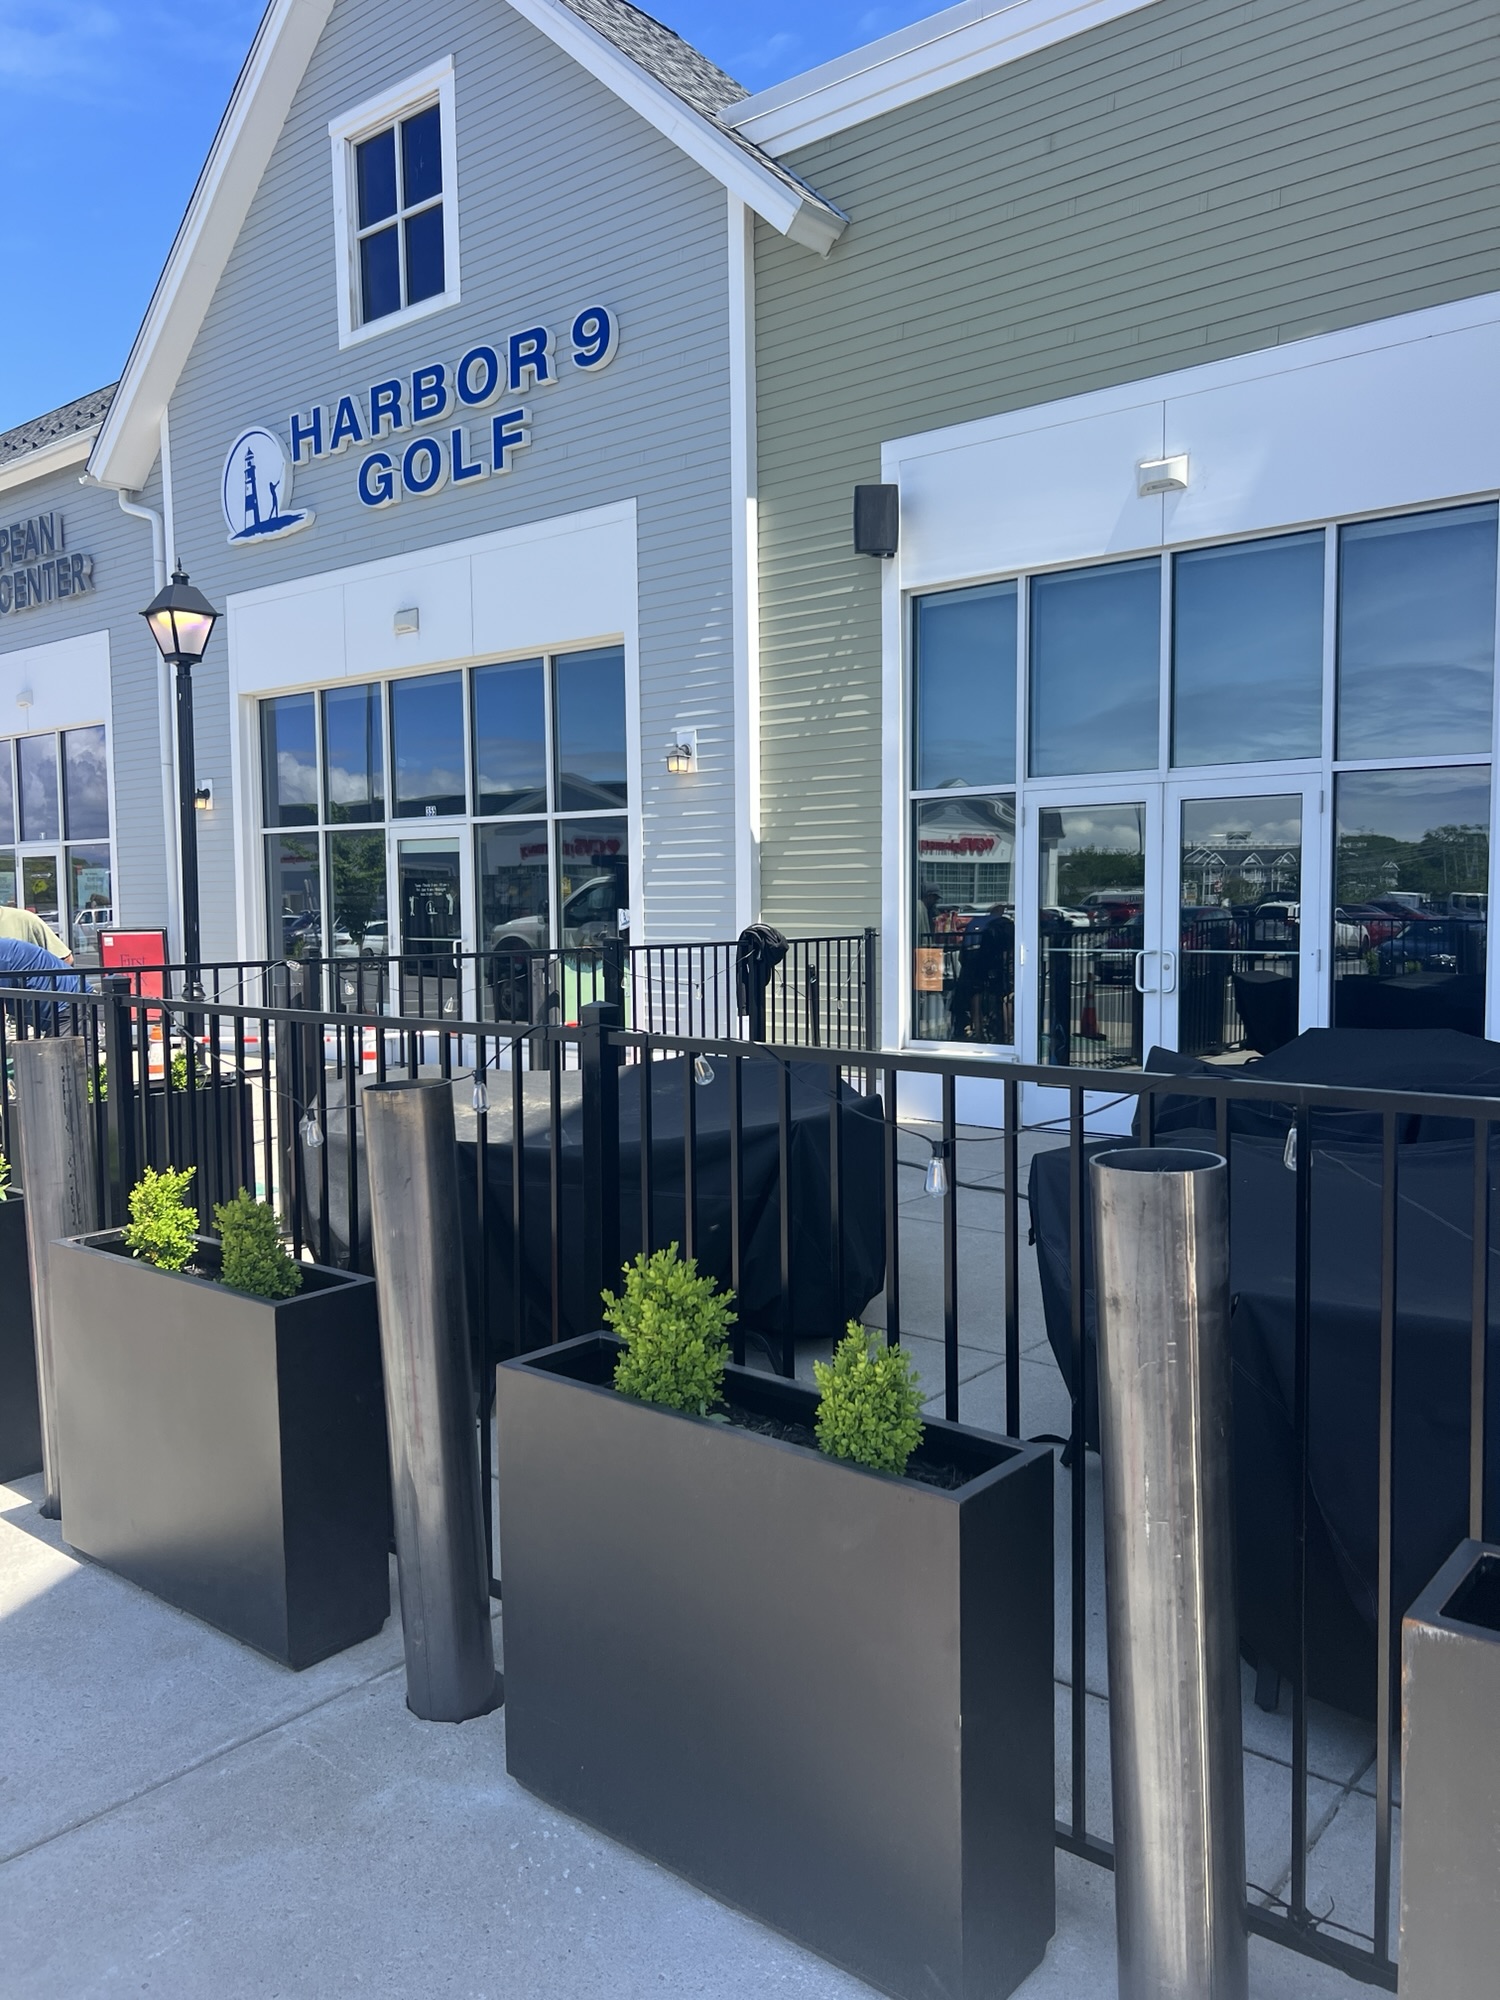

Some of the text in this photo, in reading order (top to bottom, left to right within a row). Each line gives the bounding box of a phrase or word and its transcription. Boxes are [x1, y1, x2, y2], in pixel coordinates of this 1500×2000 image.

[289, 304, 620, 466] HARBOR 9
[356, 406, 533, 509] GOLF
[0, 553, 90, 615] CENTER
[120, 953, 146, 967] First
